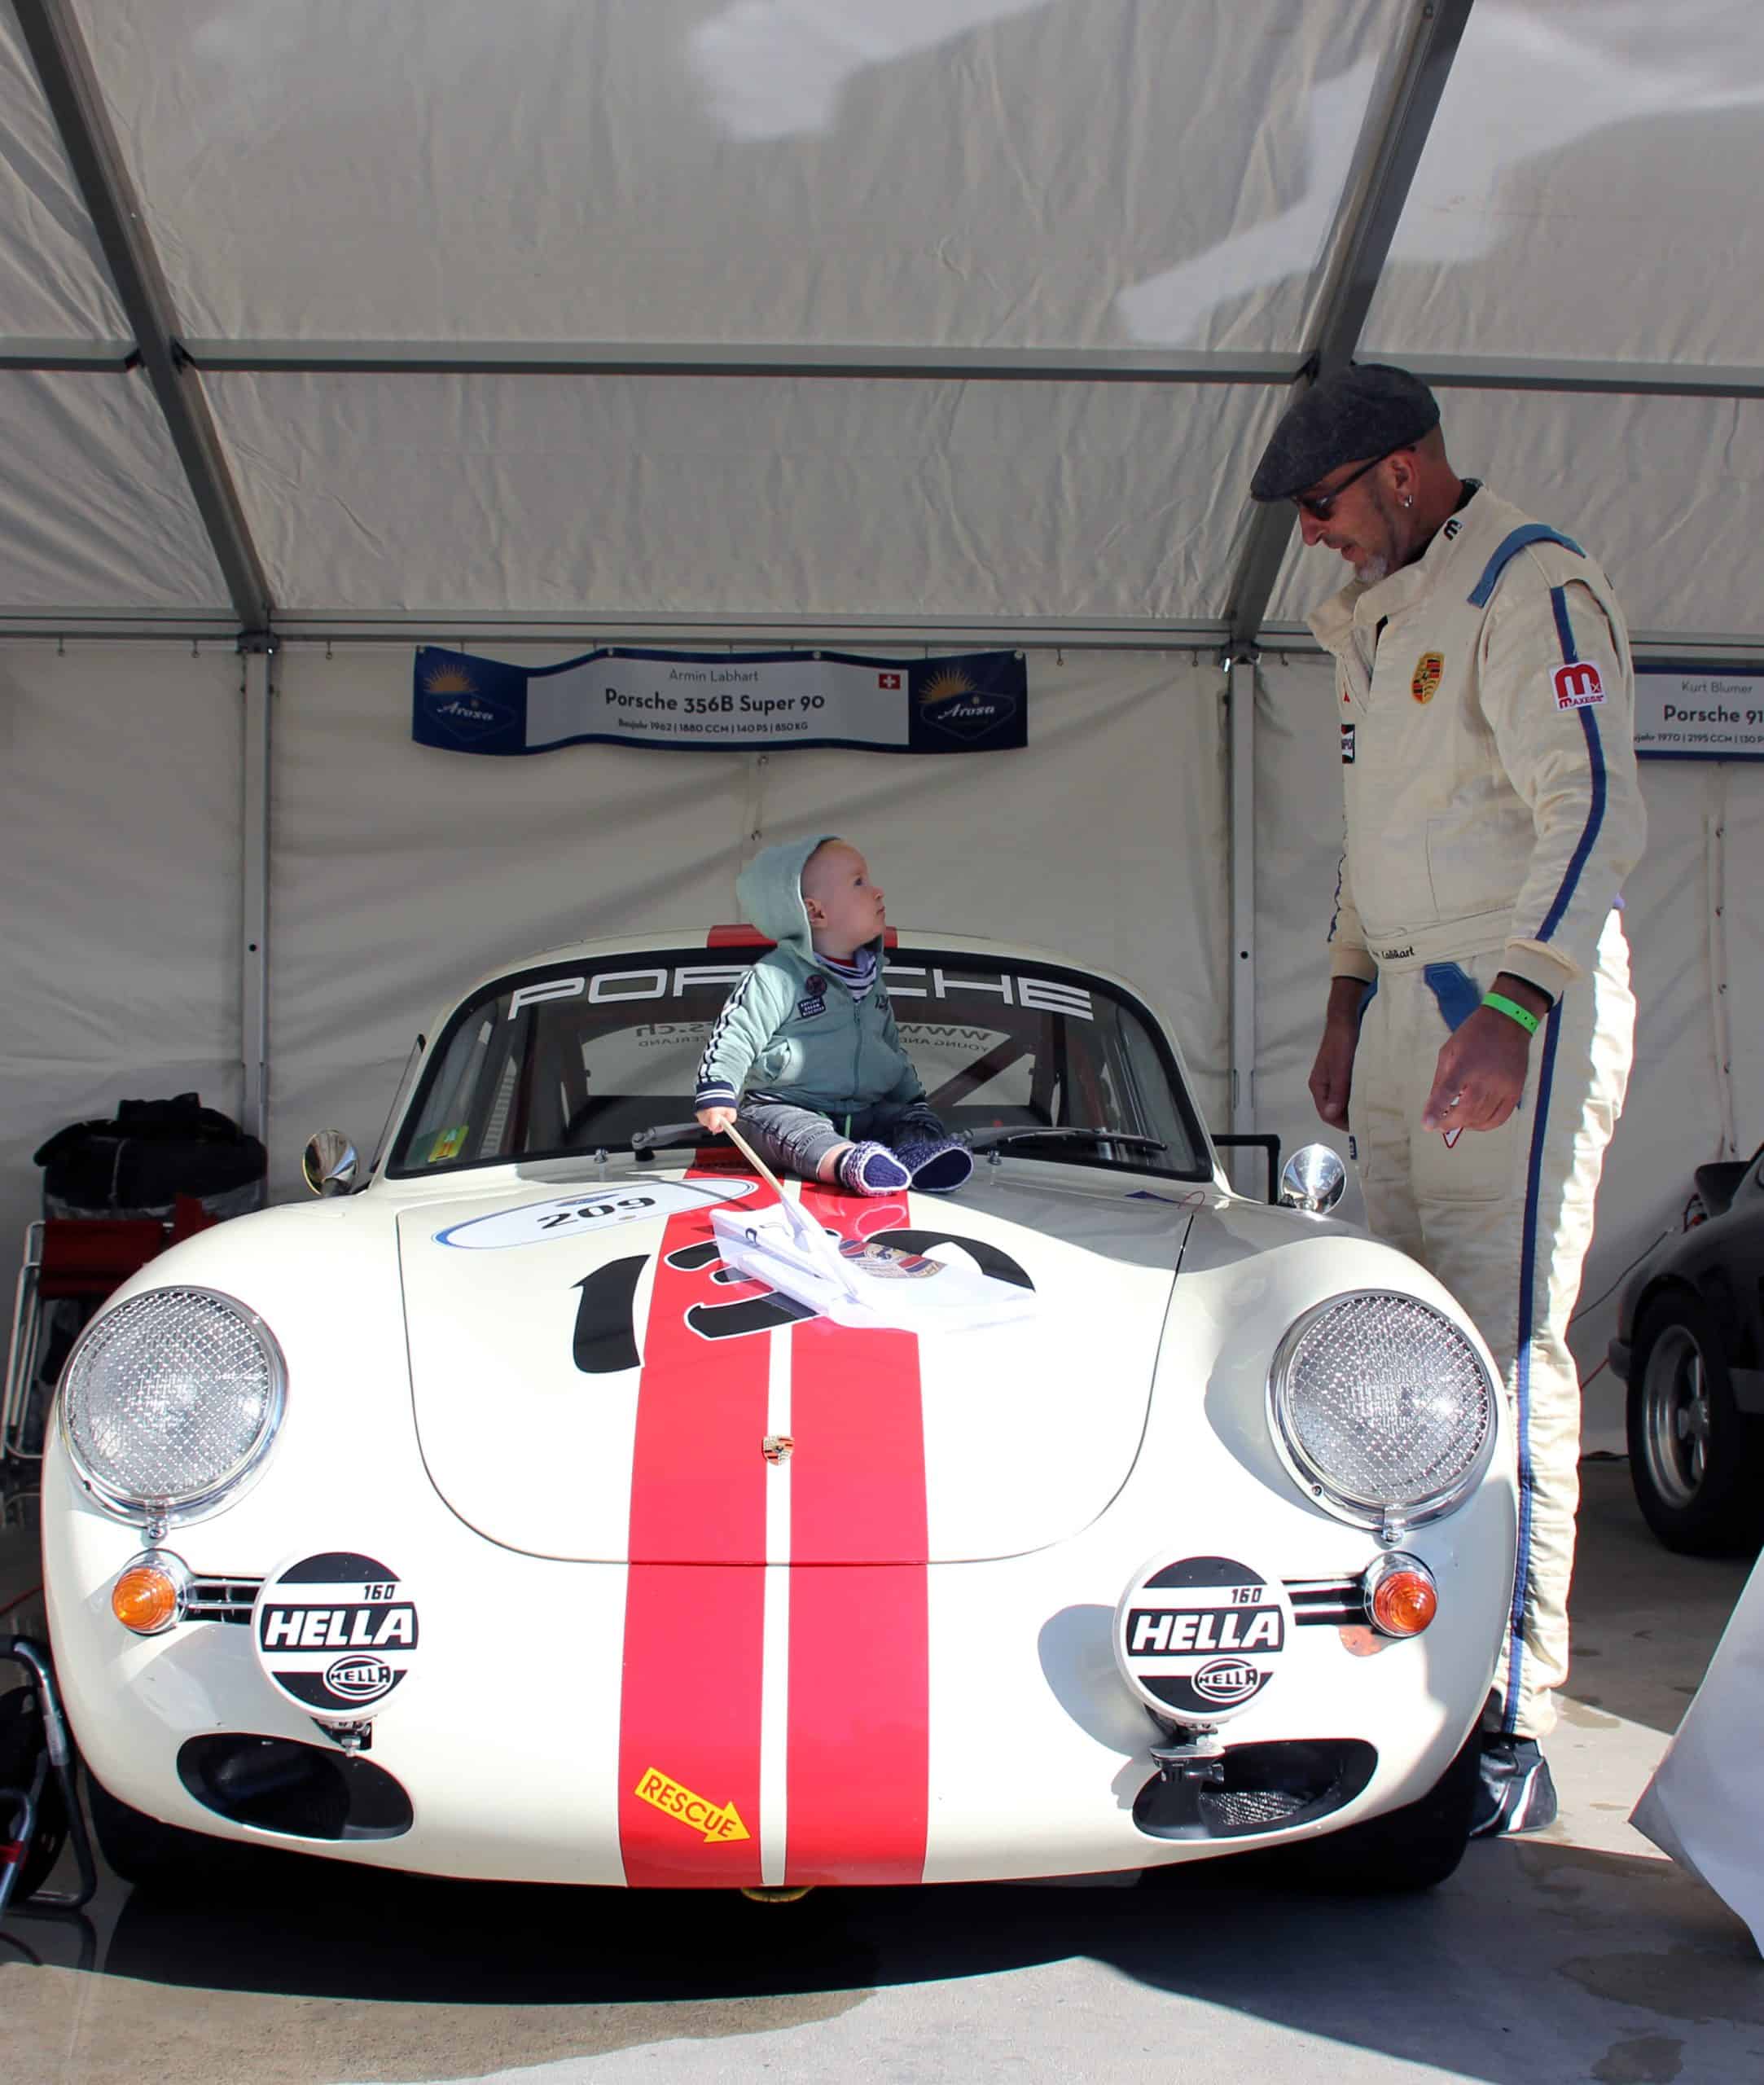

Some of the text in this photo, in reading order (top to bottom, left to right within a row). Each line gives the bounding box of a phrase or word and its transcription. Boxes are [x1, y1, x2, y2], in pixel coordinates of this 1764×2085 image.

[669, 668, 758, 682] Armin Labhart
[1681, 681, 1753, 693] Kurt Blumer
[605, 687, 825, 717] Porsche 356B Super 90
[938, 703, 995, 720] Arosa
[1664, 704, 1740, 722] Porsche
[537, 1197, 656, 1230] 209
[363, 1584, 396, 1600] 160
[1231, 1587, 1263, 1604] 160
[264, 1609, 413, 1646] HELLA
[1131, 1611, 1279, 1650] HELLA
[330, 1666, 392, 1683] HELLA
[1198, 1668, 1258, 1686] HELLA
[643, 1774, 736, 1837] RESCUE
